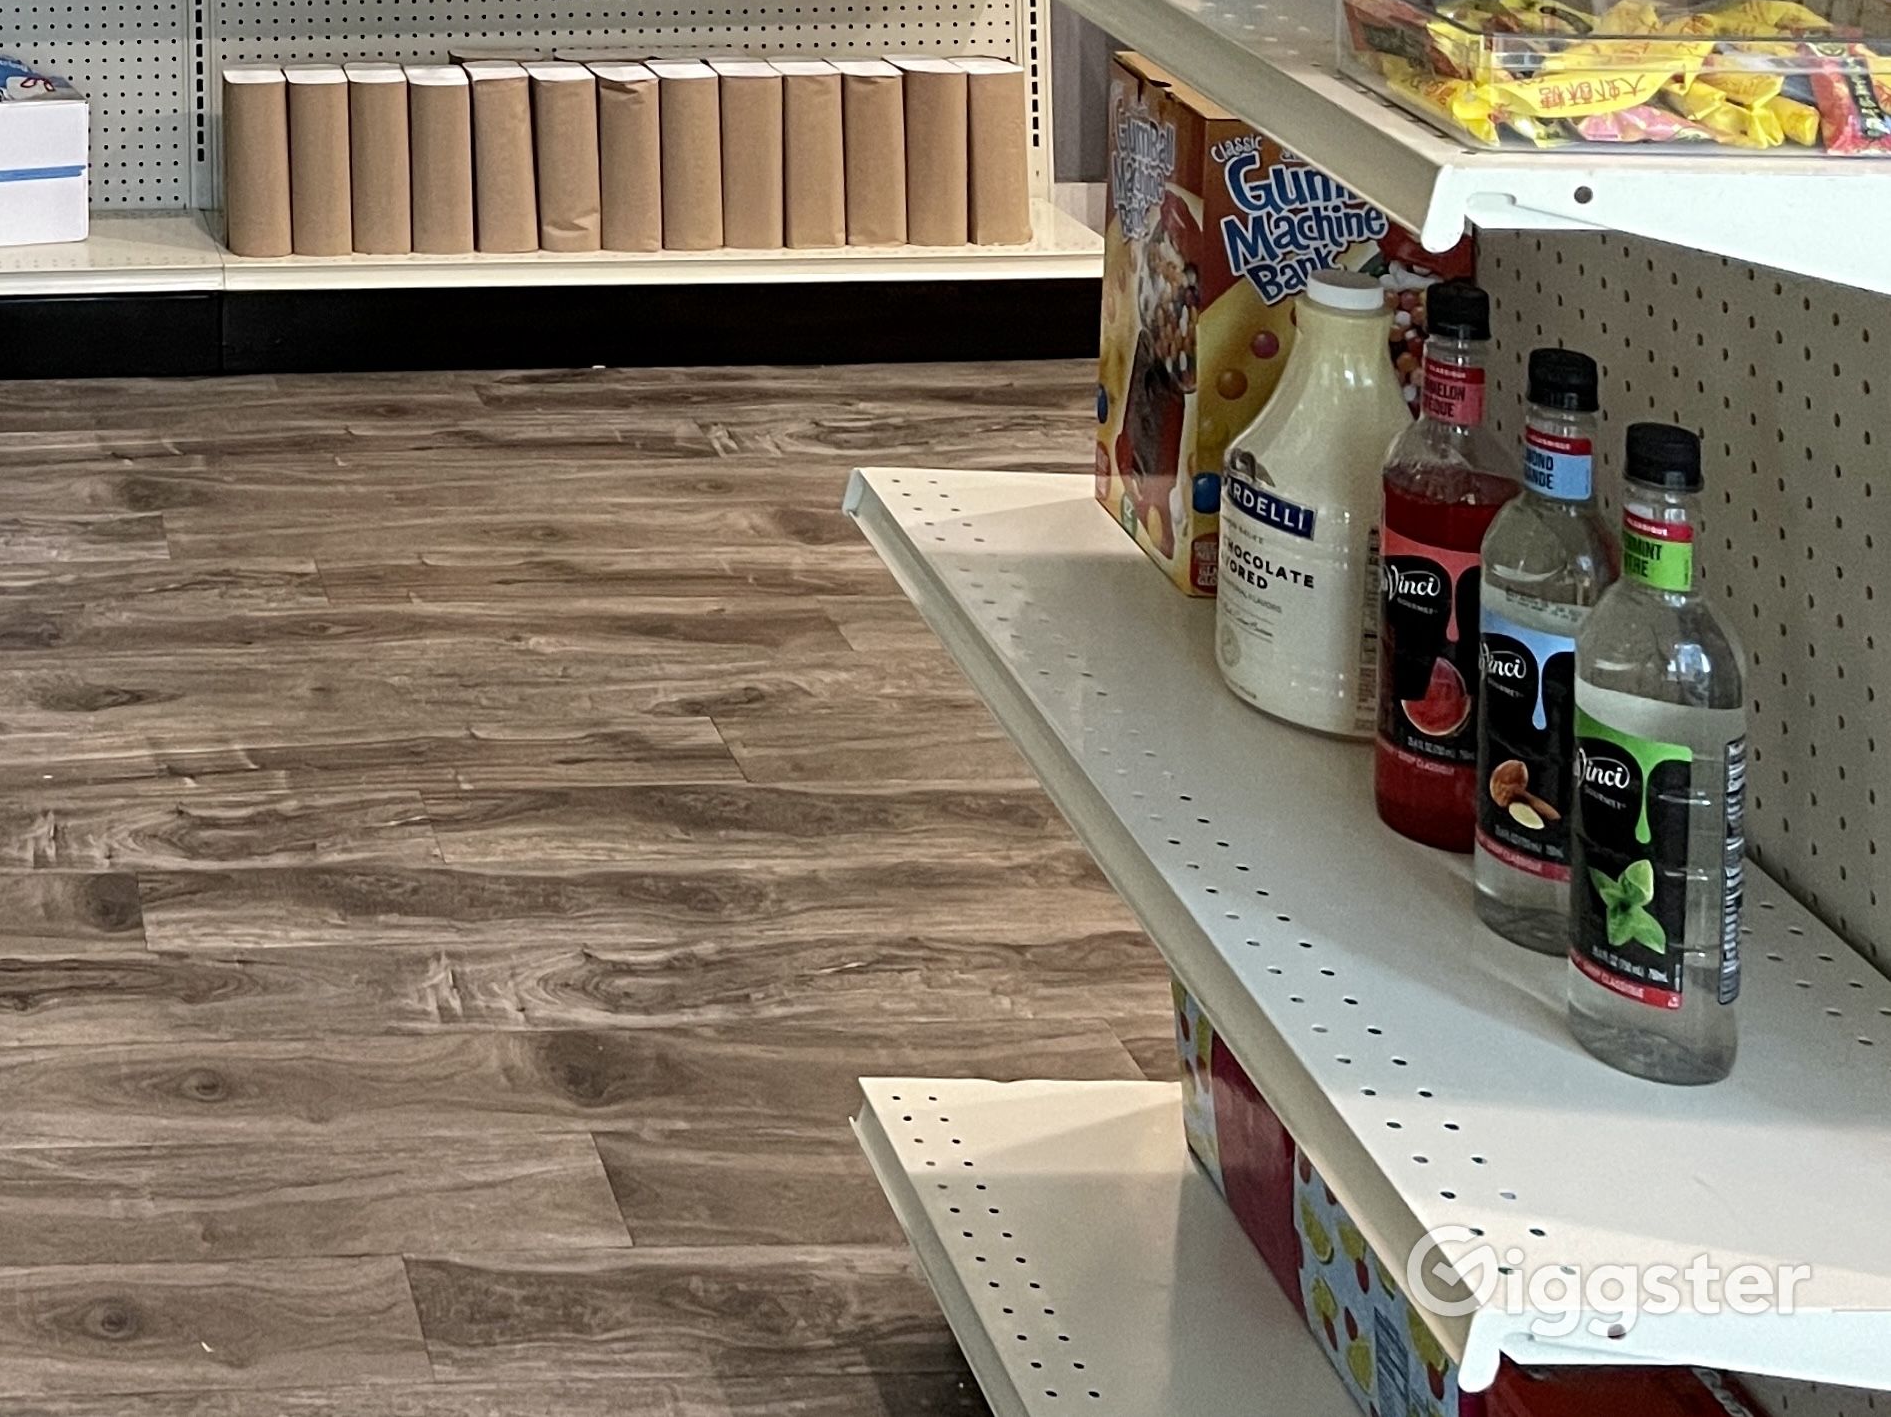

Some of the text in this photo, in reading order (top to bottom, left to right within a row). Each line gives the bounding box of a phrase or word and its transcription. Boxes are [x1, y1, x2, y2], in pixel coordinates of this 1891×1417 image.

[1538, 72, 1646, 110] 大虾酥糖
[1211, 135, 1263, 163] Classic
[1222, 204, 1389, 275] Machine
[1247, 245, 1338, 305] Bank
